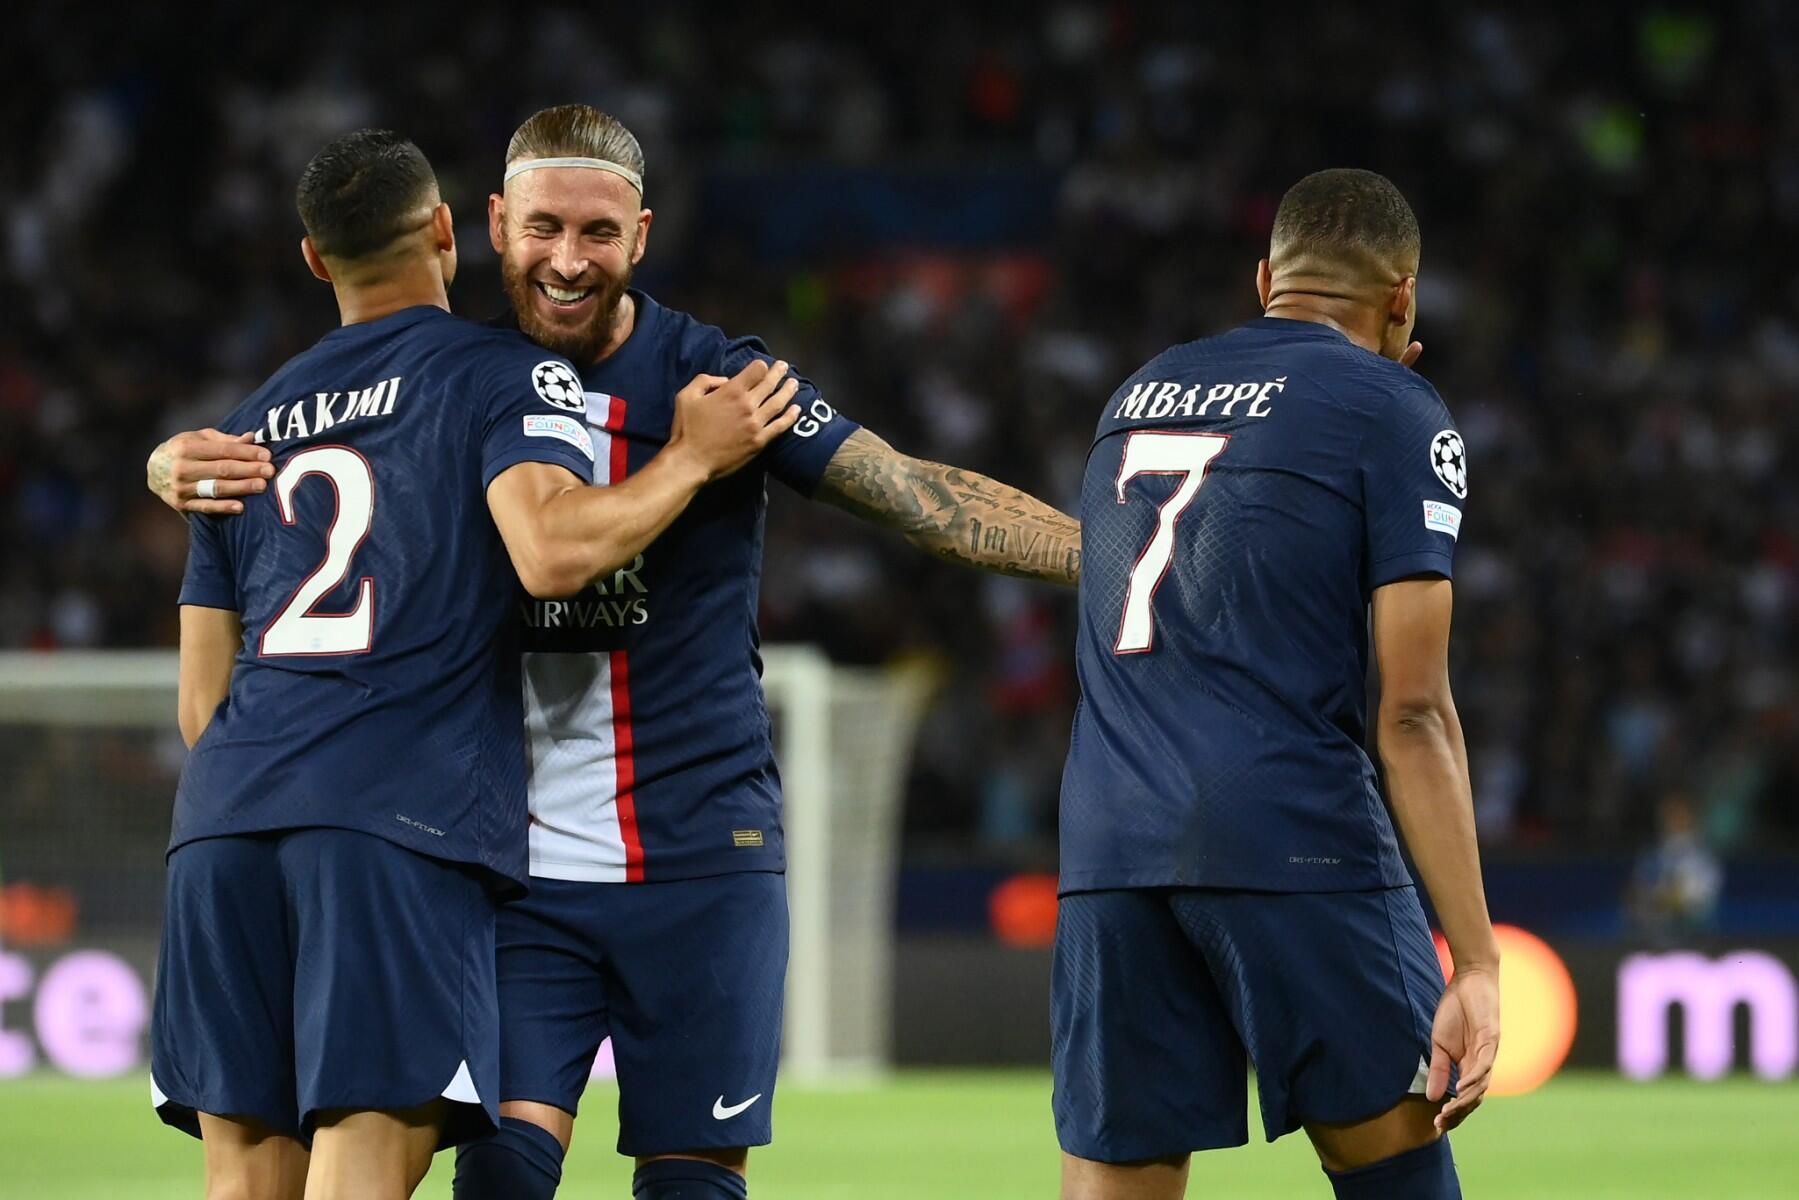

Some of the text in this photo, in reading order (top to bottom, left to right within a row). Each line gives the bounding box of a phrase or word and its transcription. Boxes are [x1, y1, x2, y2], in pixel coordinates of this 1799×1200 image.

[793, 399, 837, 437] GO
[1114, 376, 1287, 420] MBAPPÉ
[257, 444, 375, 657] 2
[1114, 430, 1232, 655] 7
